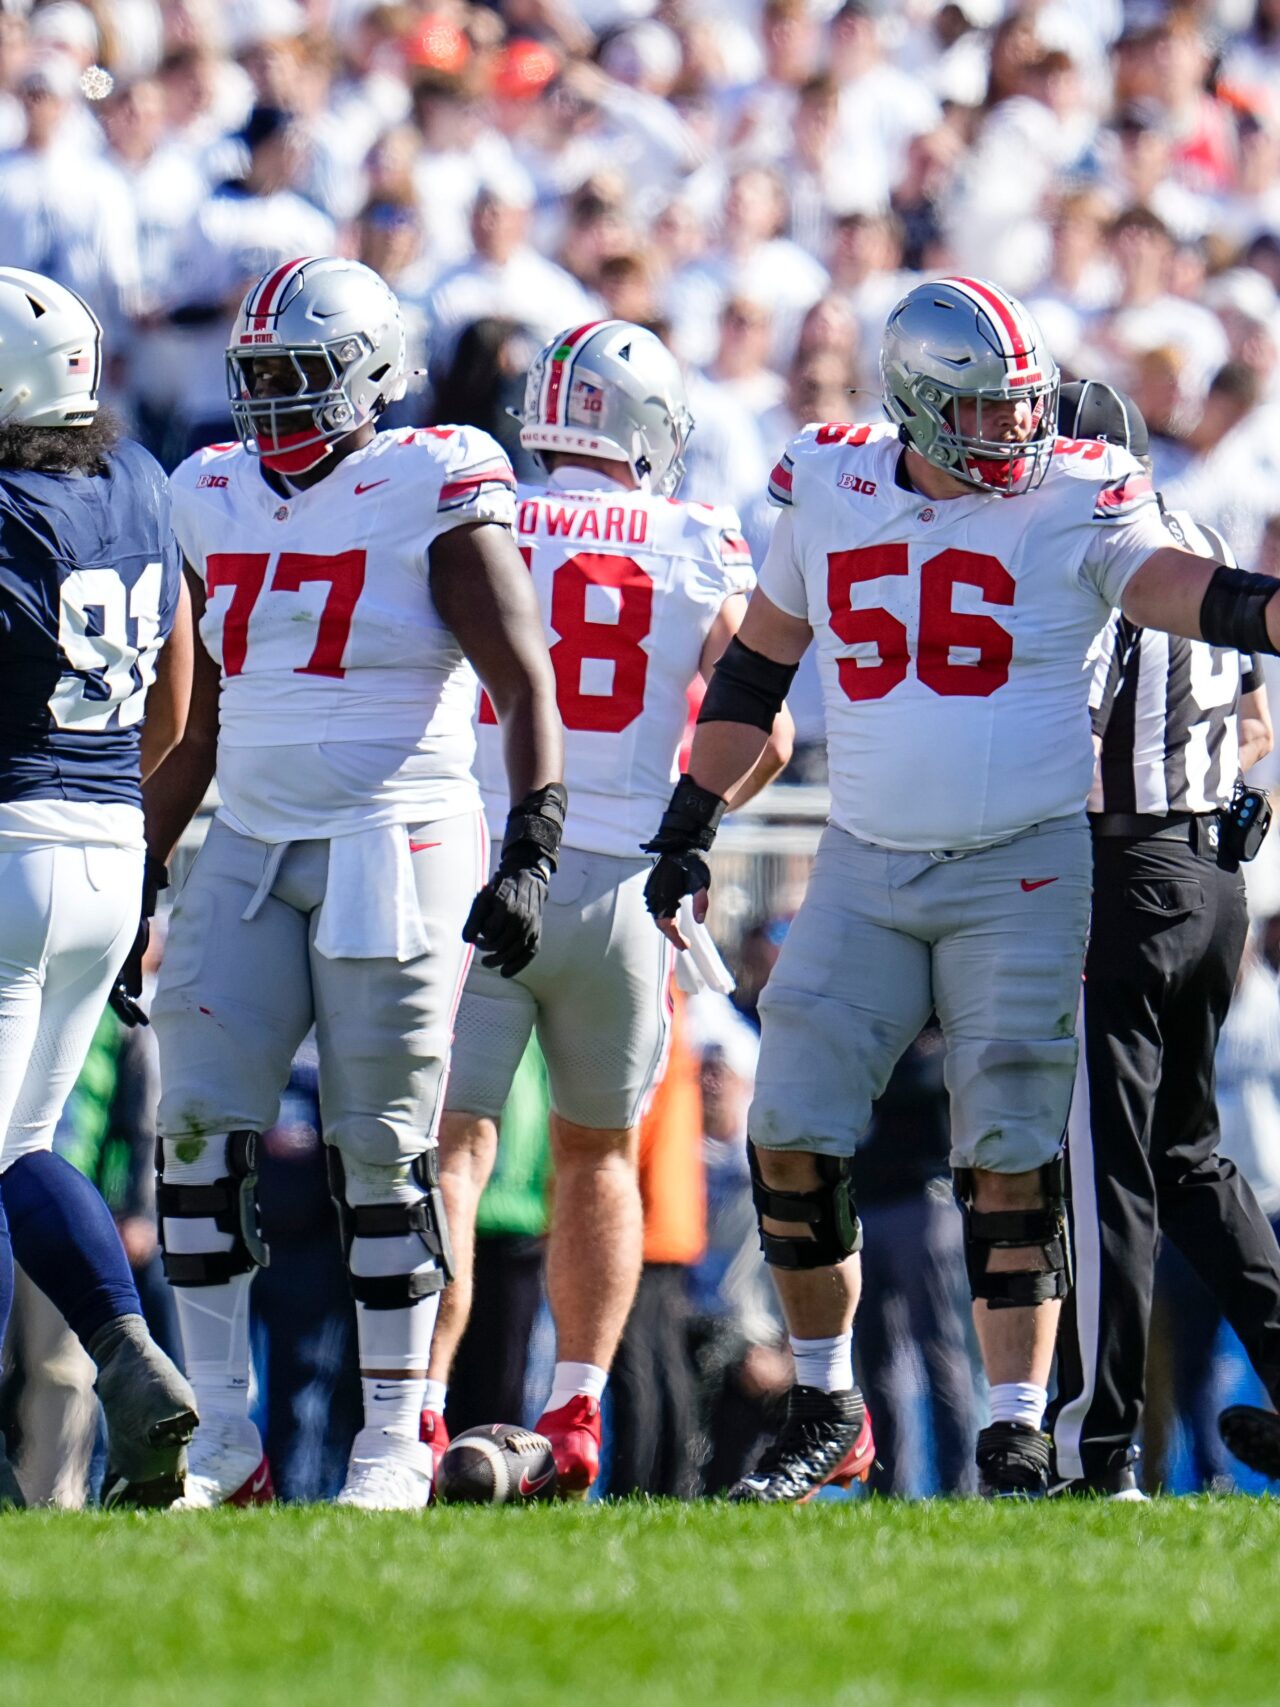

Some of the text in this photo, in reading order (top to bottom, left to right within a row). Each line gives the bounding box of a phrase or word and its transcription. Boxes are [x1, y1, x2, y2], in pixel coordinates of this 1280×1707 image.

[519, 501, 647, 544] OWARD
[48, 562, 163, 730] 91
[206, 549, 367, 680] 77
[827, 543, 1017, 702] 56
